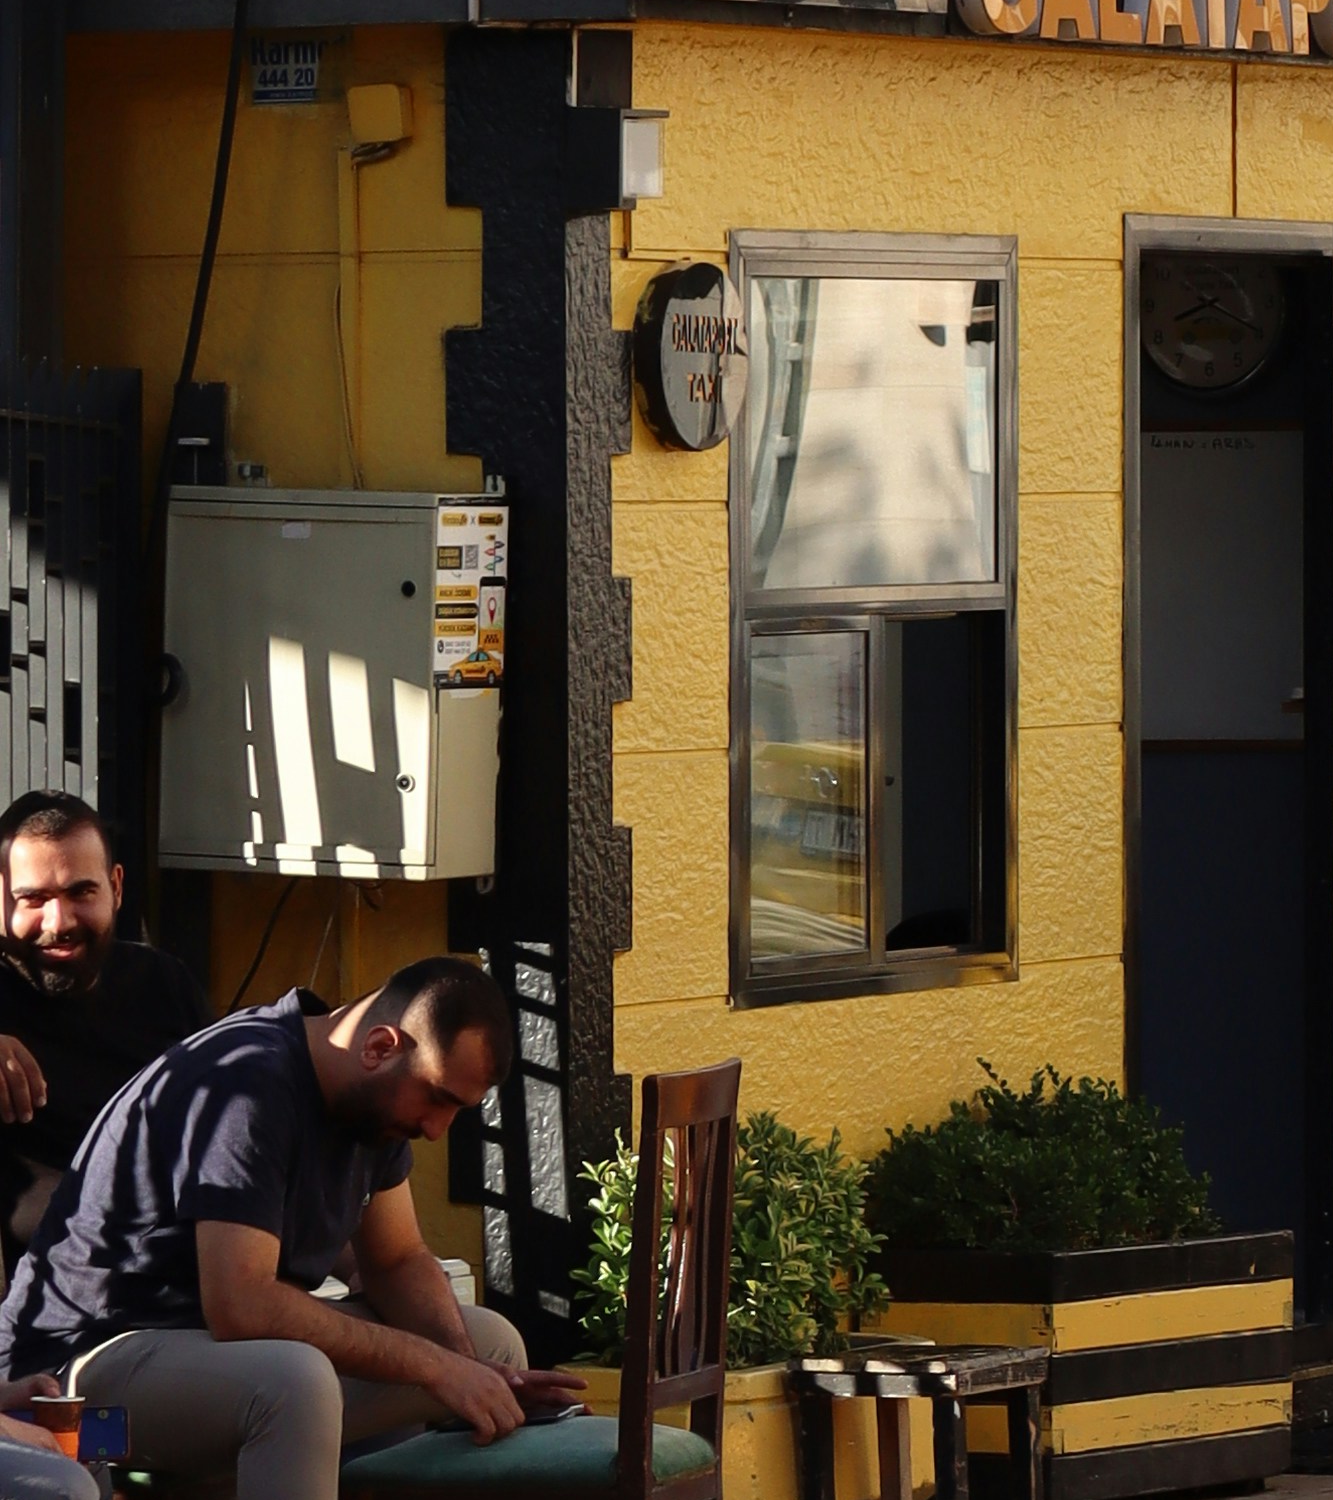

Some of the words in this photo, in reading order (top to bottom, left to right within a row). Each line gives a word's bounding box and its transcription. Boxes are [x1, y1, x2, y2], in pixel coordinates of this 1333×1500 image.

[258, 69, 289, 87] 444
[672, 313, 739, 355] GALATAPORT
[687, 373, 723, 404] TAXI
